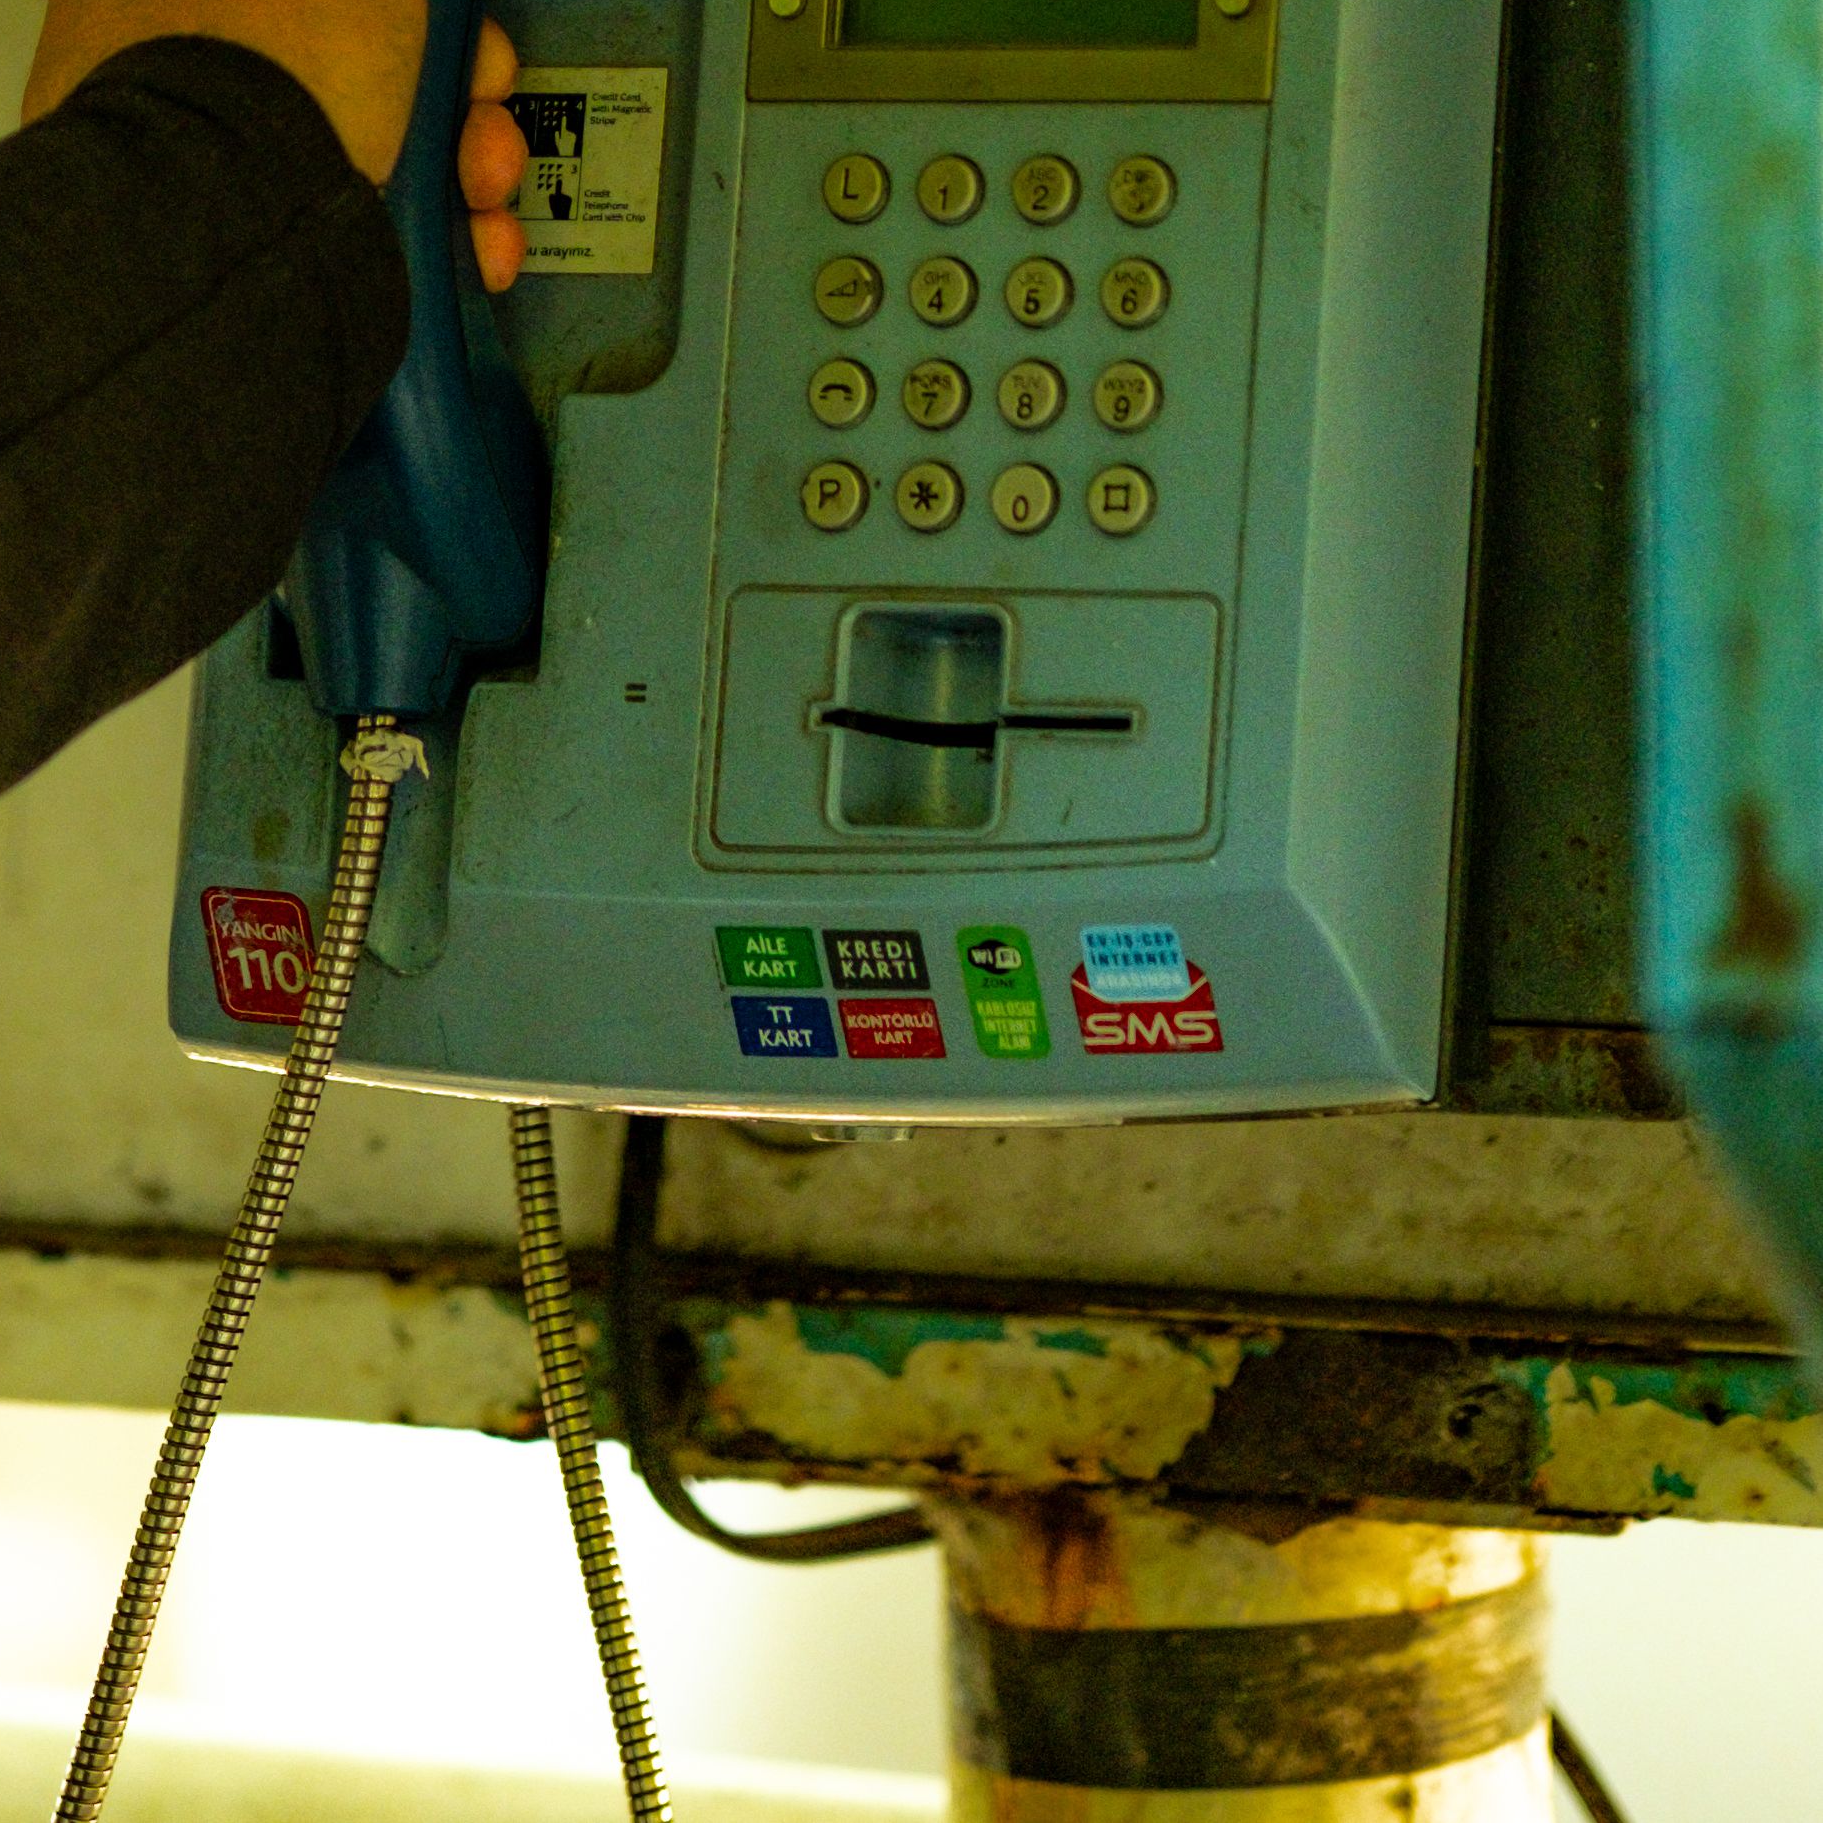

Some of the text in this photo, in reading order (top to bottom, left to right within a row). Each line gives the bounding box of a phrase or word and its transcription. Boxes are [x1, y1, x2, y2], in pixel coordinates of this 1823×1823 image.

[841, 167, 859, 200] L
[938, 185, 948, 210] 1
[1032, 184, 1050, 211] 2
[928, 287, 944, 313] 4
[1024, 289, 1040, 315] 5
[1121, 289, 1138, 315] 6
[920, 391, 939, 418] 7
[1017, 392, 1034, 420] 8
[1113, 394, 1131, 423] 9
[818, 478, 841, 509] P
[1012, 494, 1029, 523] 0
[220, 920, 300, 944] YANGIN
[746, 932, 788, 955] AİLE
[227, 946, 307, 995] 110
[743, 960, 798, 979] KART
[841, 959, 917, 979] KARTI
[982, 977, 1016, 990] ZONE
[767, 1005, 793, 1024] TT
[846, 1010, 935, 1028] KONTÖRLÜ
[758, 1027, 813, 1049] KART
[873, 1030, 914, 1045] KART
[1083, 1010, 1216, 1046] SMS
